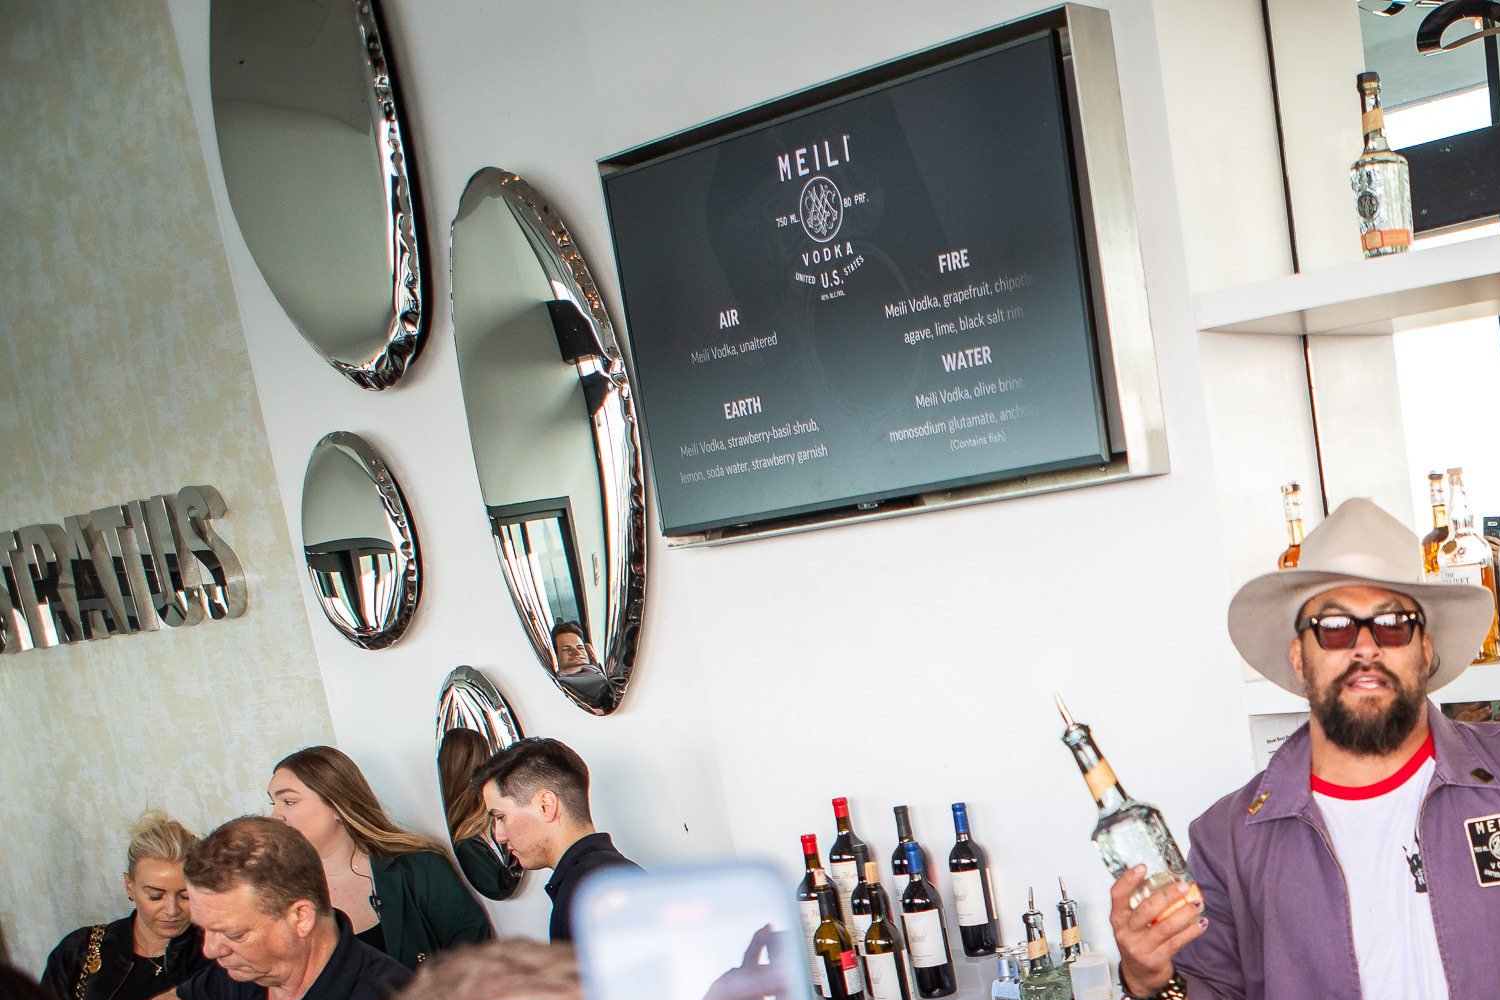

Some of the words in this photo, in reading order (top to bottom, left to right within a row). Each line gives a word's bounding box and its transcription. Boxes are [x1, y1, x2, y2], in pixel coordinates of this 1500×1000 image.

[777, 135, 850, 182] MEILI
[843, 197, 851, 208] 80
[776, 216, 788, 228] 750
[802, 241, 854, 267] VODKA
[843, 254, 865, 276] STATES
[937, 248, 970, 274] FIRE
[795, 271, 816, 285] UNITED
[821, 270, 844, 289] U.S.
[884, 301, 908, 319] Meili
[908, 294, 941, 313] Vodka,
[943, 282, 993, 308] grapefruit,
[719, 308, 740, 330] AIR
[904, 327, 934, 346] agave,
[935, 321, 958, 337] lime,
[959, 312, 986, 331] black
[987, 307, 1005, 325] salt
[1006, 305, 1024, 321] rim
[691, 349, 711, 365] Meili
[711, 343, 739, 360] Vodka,
[739, 331, 778, 353] unaltered
[941, 345, 993, 373] WATER
[723, 396, 762, 420] EARTH
[915, 391, 939, 409] Meili
[939, 386, 972, 404] Vodka,
[974, 382, 997, 398] olive
[889, 419, 947, 442] monosodium
[948, 411, 998, 434] glutamate,
[1000, 403, 1041, 422] anchov
[680, 442, 699, 458] Meili
[699, 438, 727, 455] Vodka,
[727, 423, 792, 449] strawberry-basil
[793, 418, 820, 436] shrub,
[950, 436, 988, 452] (Contains
[988, 430, 1006, 444] fish)
[680, 469, 706, 484] lemon,
[706, 465, 725, 480] soda
[726, 460, 751, 476] water,
[751, 451, 795, 471] strawberry
[797, 443, 828, 464] garnish
[0, 485, 247, 655] TRATUS
